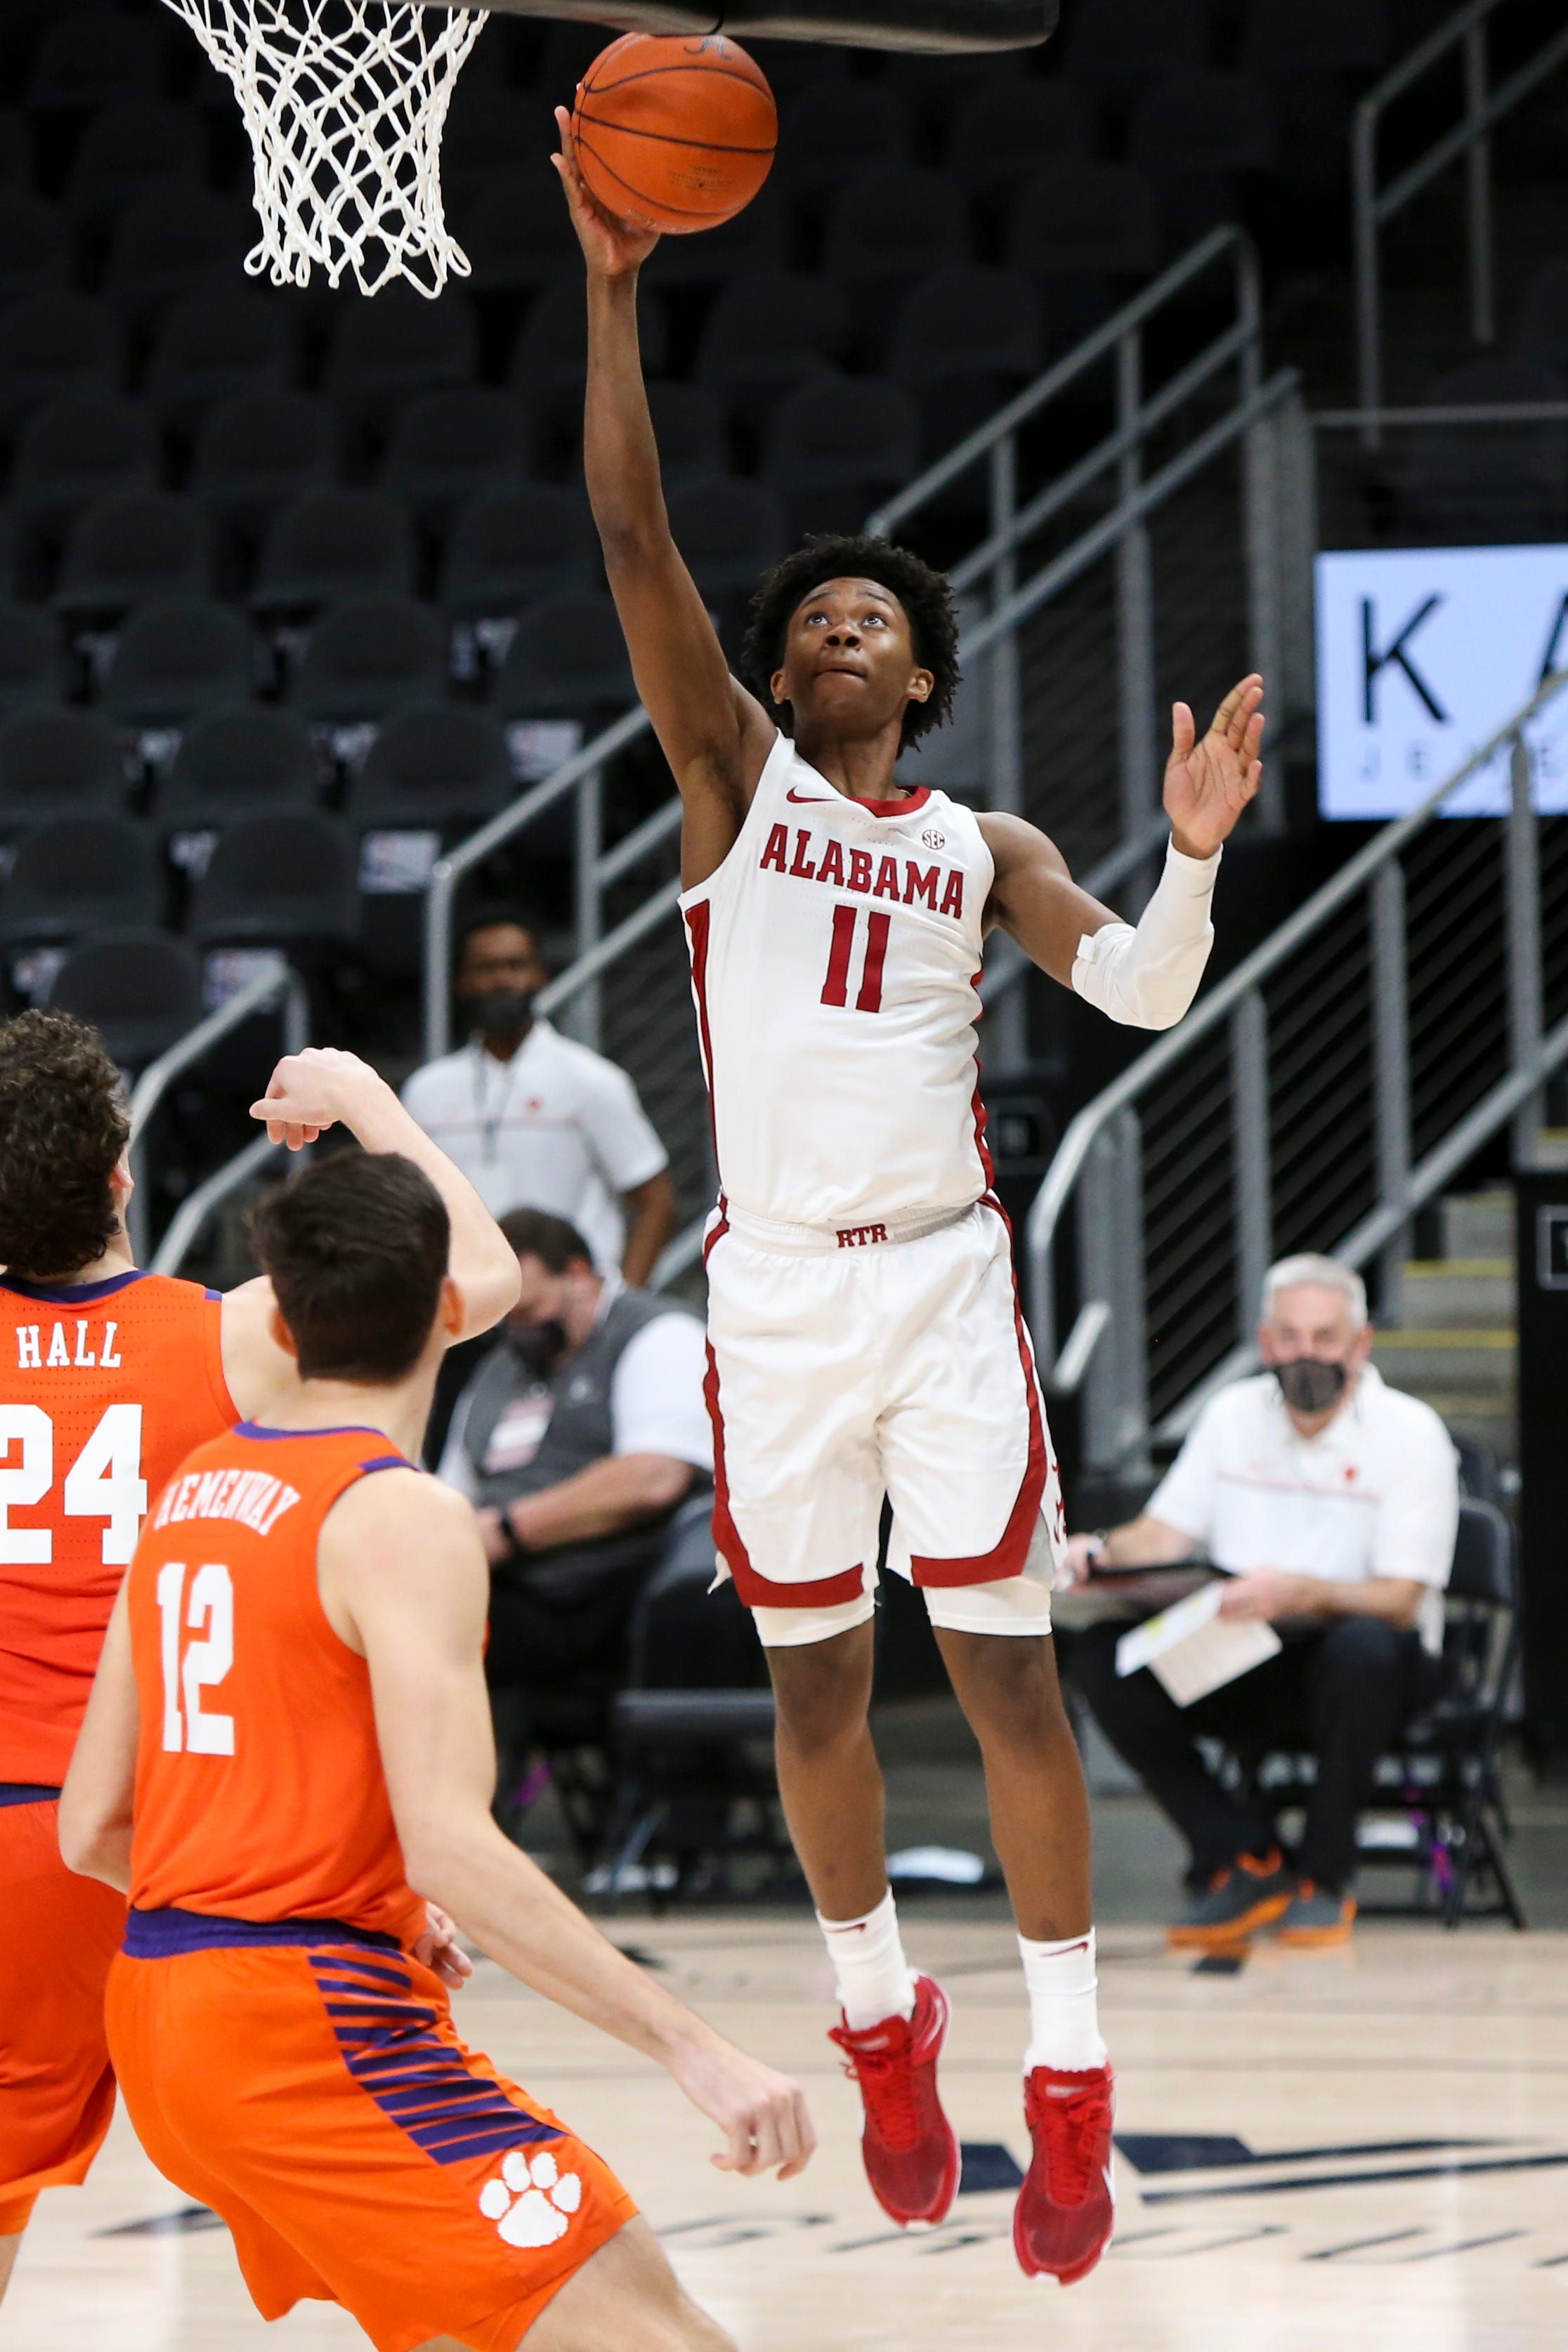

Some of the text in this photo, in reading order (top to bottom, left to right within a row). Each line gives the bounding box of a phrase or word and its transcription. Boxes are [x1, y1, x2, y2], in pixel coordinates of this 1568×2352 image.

[759, 823, 964, 919] ALABAMA
[922, 830, 945, 849] SEC
[821, 904, 891, 1012] 11
[836, 1223, 887, 1248] RTR
[16, 1320, 122, 1368] HALL
[0, 1404, 148, 1564] 24
[157, 1562, 235, 1756] 12
